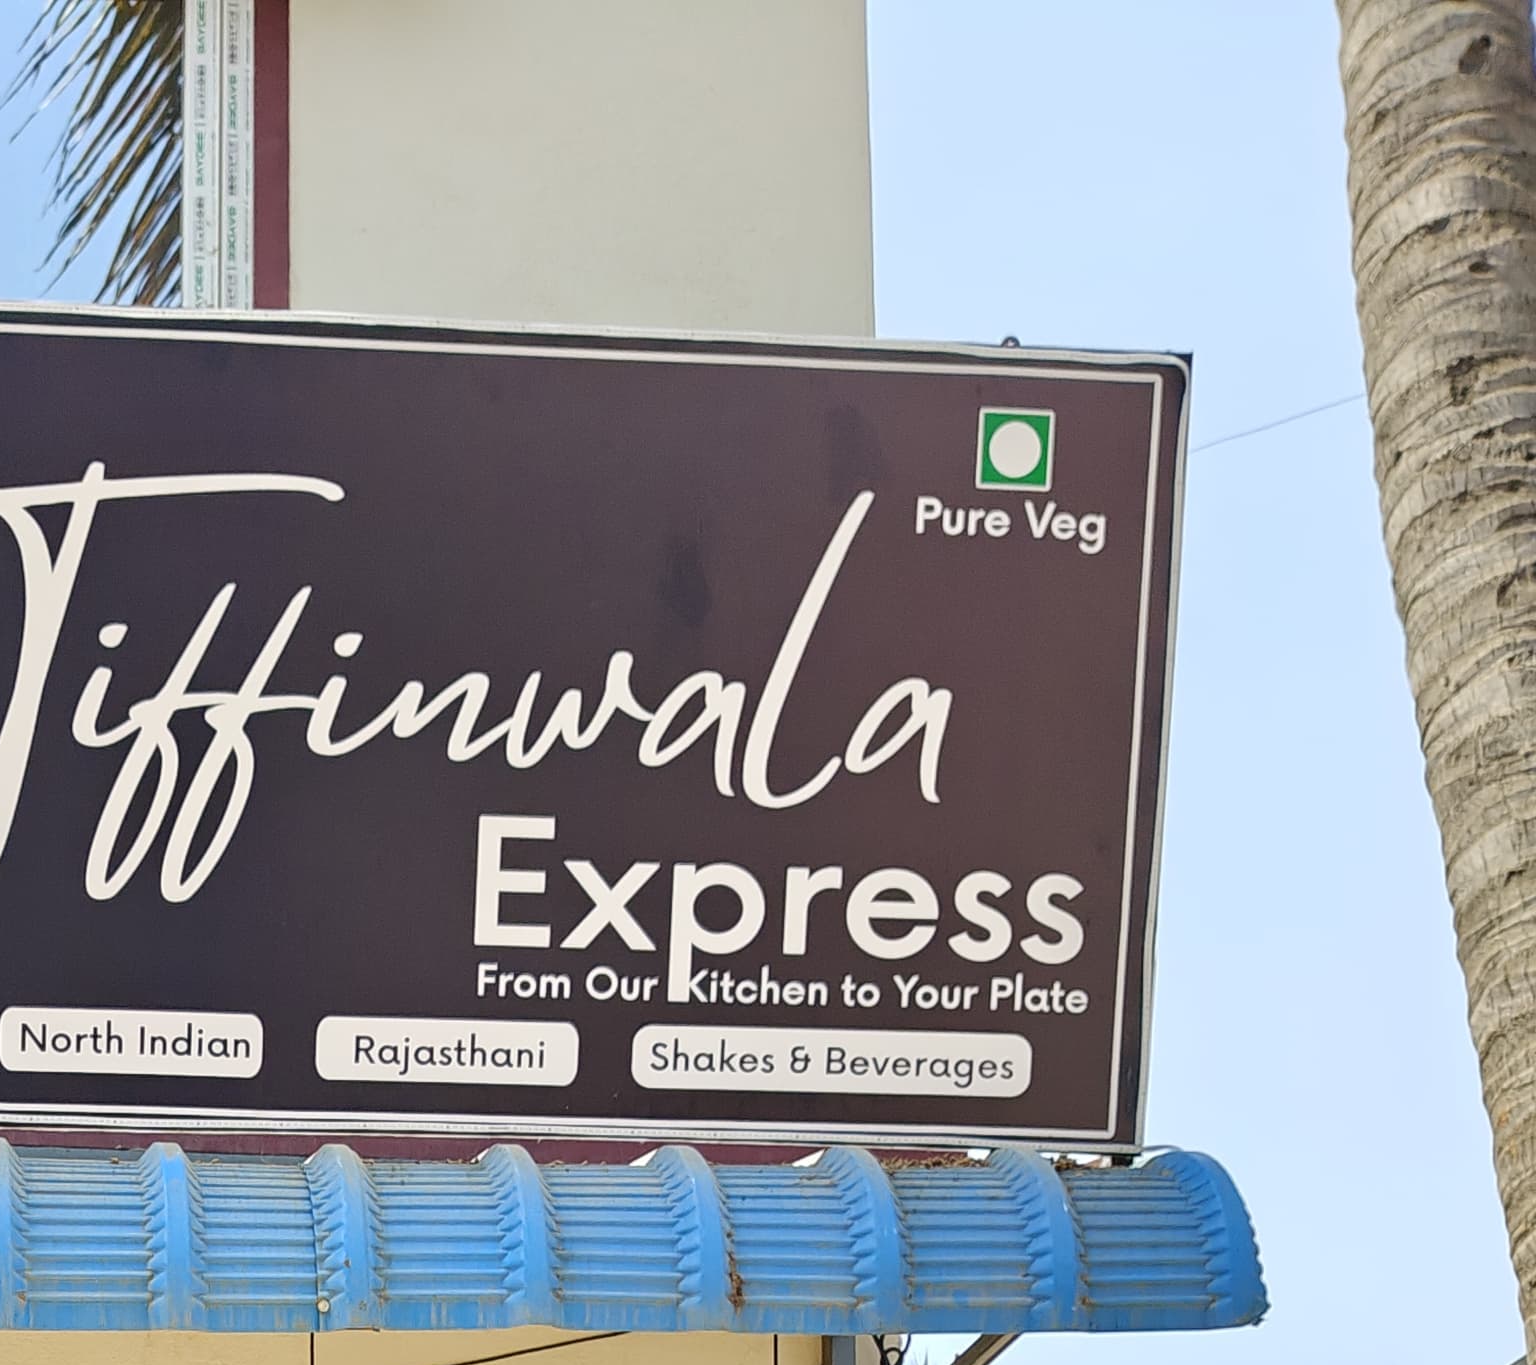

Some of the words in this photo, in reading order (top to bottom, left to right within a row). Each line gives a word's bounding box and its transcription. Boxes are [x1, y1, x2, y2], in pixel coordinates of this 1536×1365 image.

[916, 497, 1010, 536] Pure
[1025, 502, 1105, 553] Veg
[473, 814, 1086, 1003] Express
[478, 963, 570, 998] From
[586, 967, 658, 1000] Our
[687, 964, 828, 1008] Kitchen
[842, 975, 880, 1006] to
[894, 975, 978, 1009] Your
[991, 973, 1088, 1013] Plate
[22, 1021, 122, 1053] North
[141, 1023, 249, 1057] Indian
[355, 1034, 543, 1074] Rajasthani
[652, 1039, 773, 1072] Shakes
[791, 1047, 810, 1073] &
[827, 1048, 1012, 1087] Beverages
